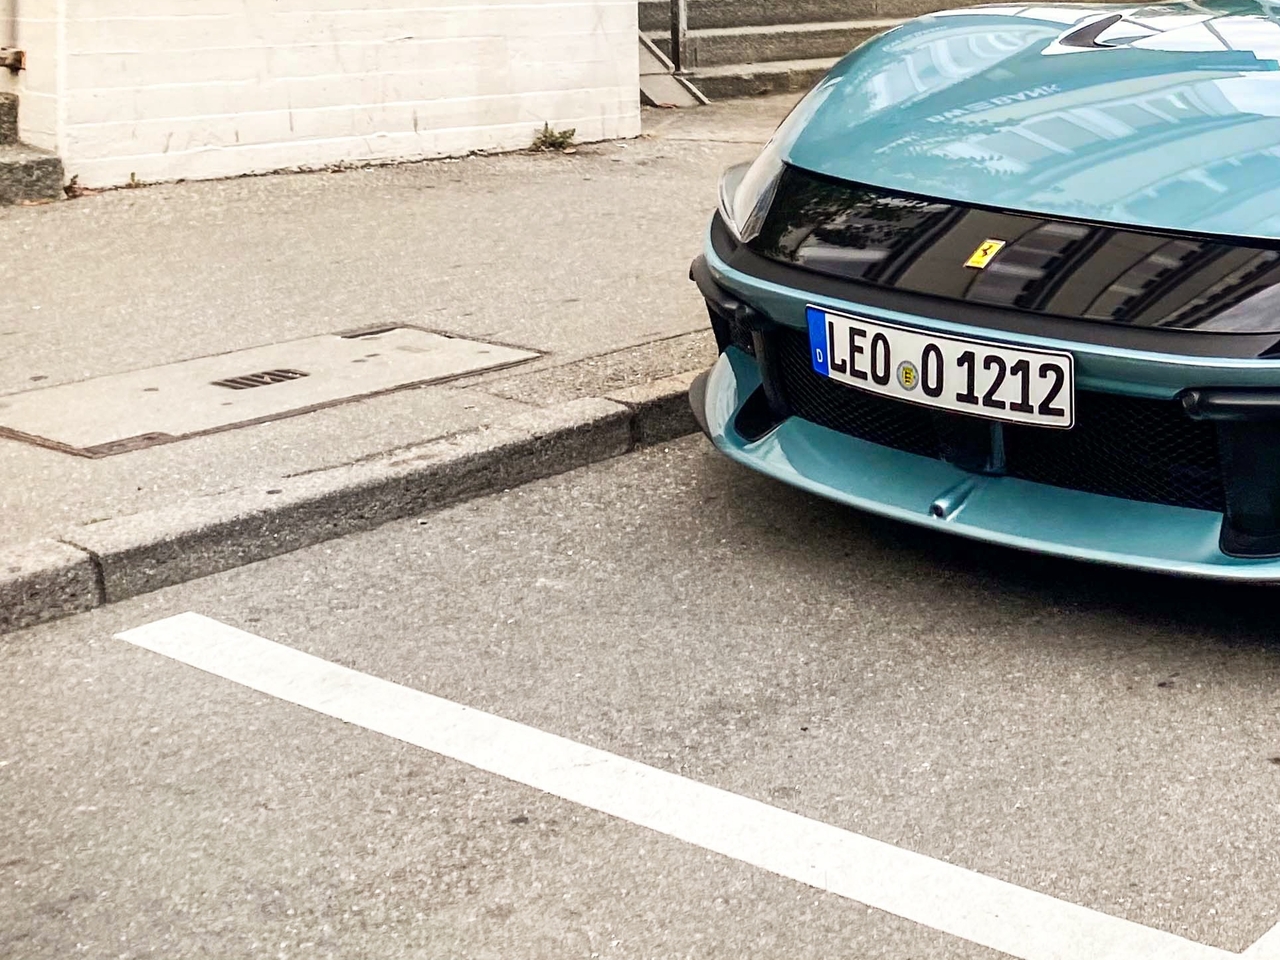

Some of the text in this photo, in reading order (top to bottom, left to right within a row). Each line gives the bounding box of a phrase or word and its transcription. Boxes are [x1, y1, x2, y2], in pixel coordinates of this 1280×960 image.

[816, 349, 823, 363] D
[828, 321, 890, 386] LEO
[956, 351, 1065, 417] 1212
